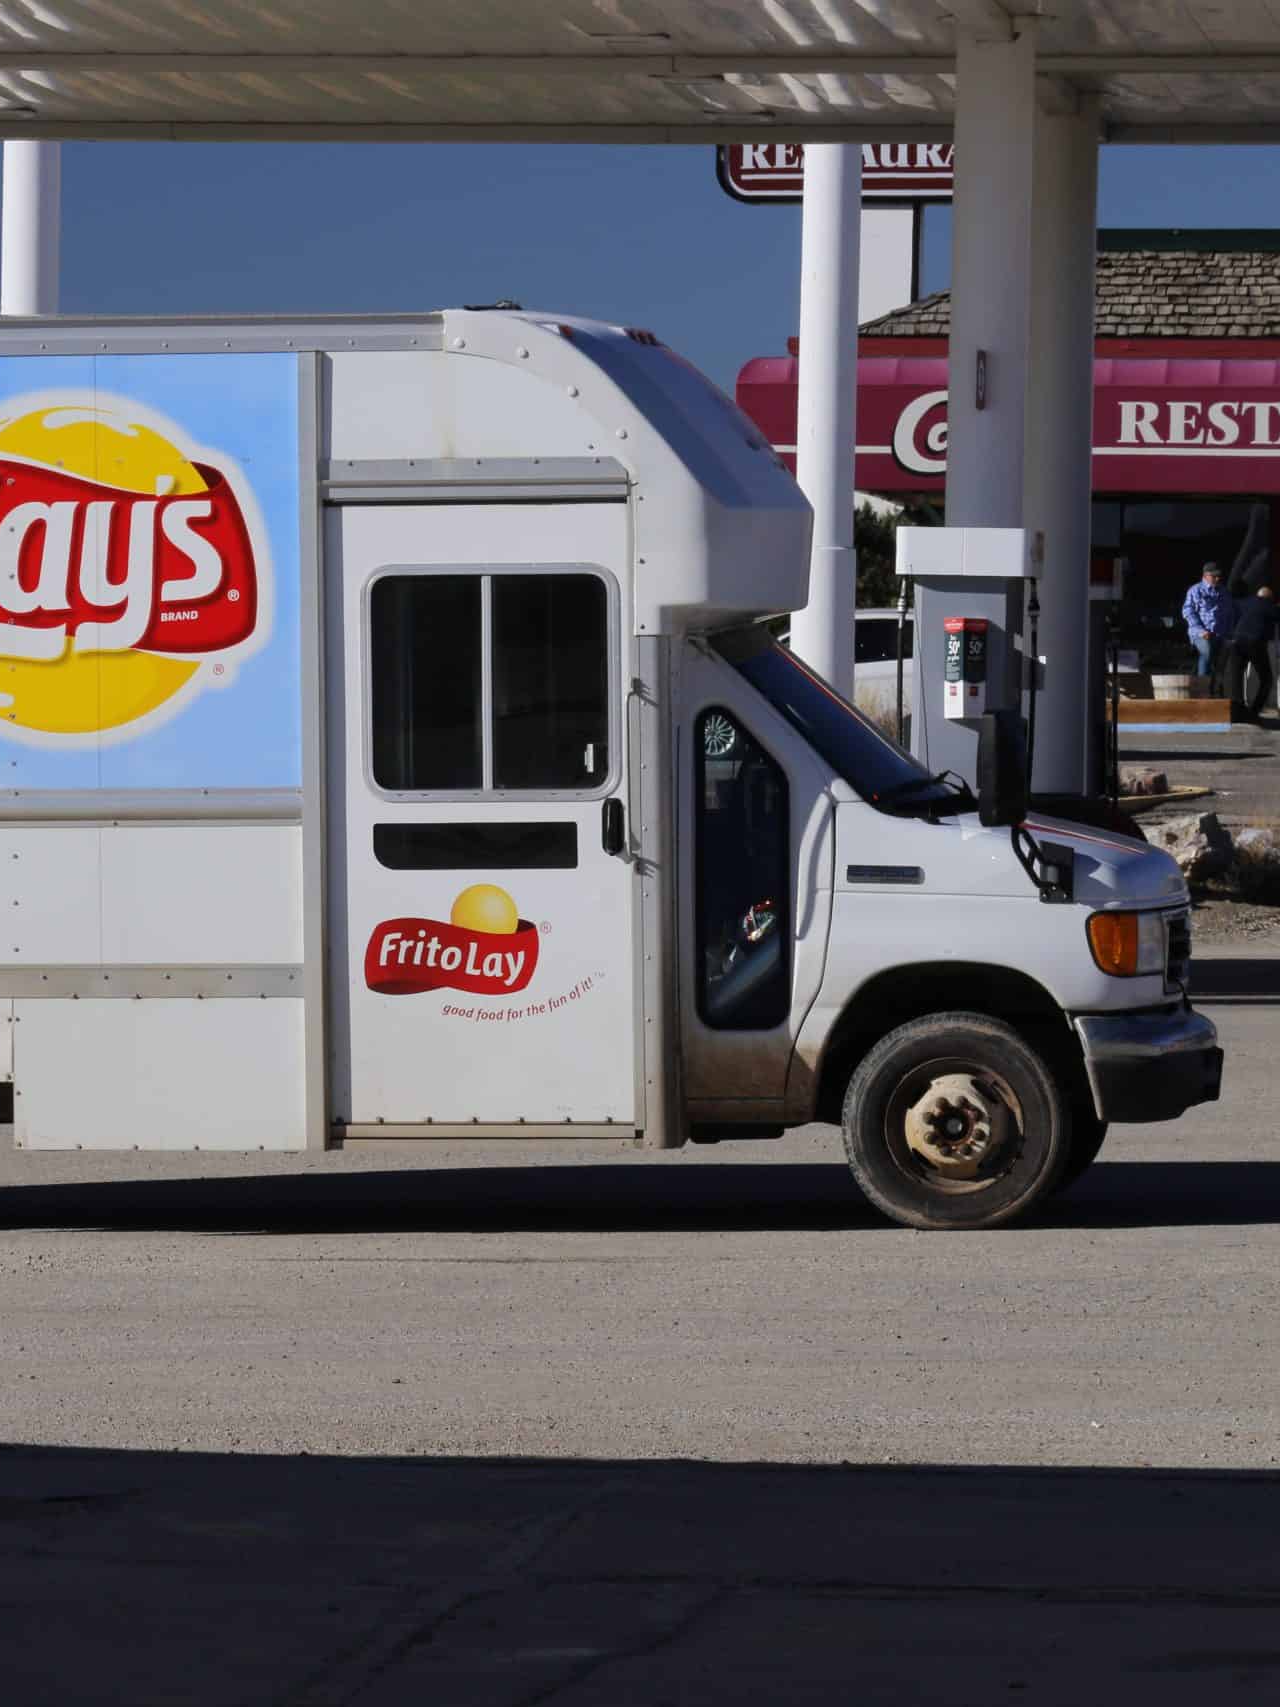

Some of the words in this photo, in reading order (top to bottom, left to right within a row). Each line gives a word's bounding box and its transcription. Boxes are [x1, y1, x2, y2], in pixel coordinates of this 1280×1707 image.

[1117, 400, 1280, 446] REST
[161, 610, 199, 622] BRAND
[442, 1004, 473, 1019] good
[476, 1009, 504, 1022] food
[507, 1009, 523, 1022] for
[527, 1005, 546, 1017] the
[548, 996, 568, 1012] fun
[569, 985, 581, 1000] of
[581, 976, 594, 993] it!
